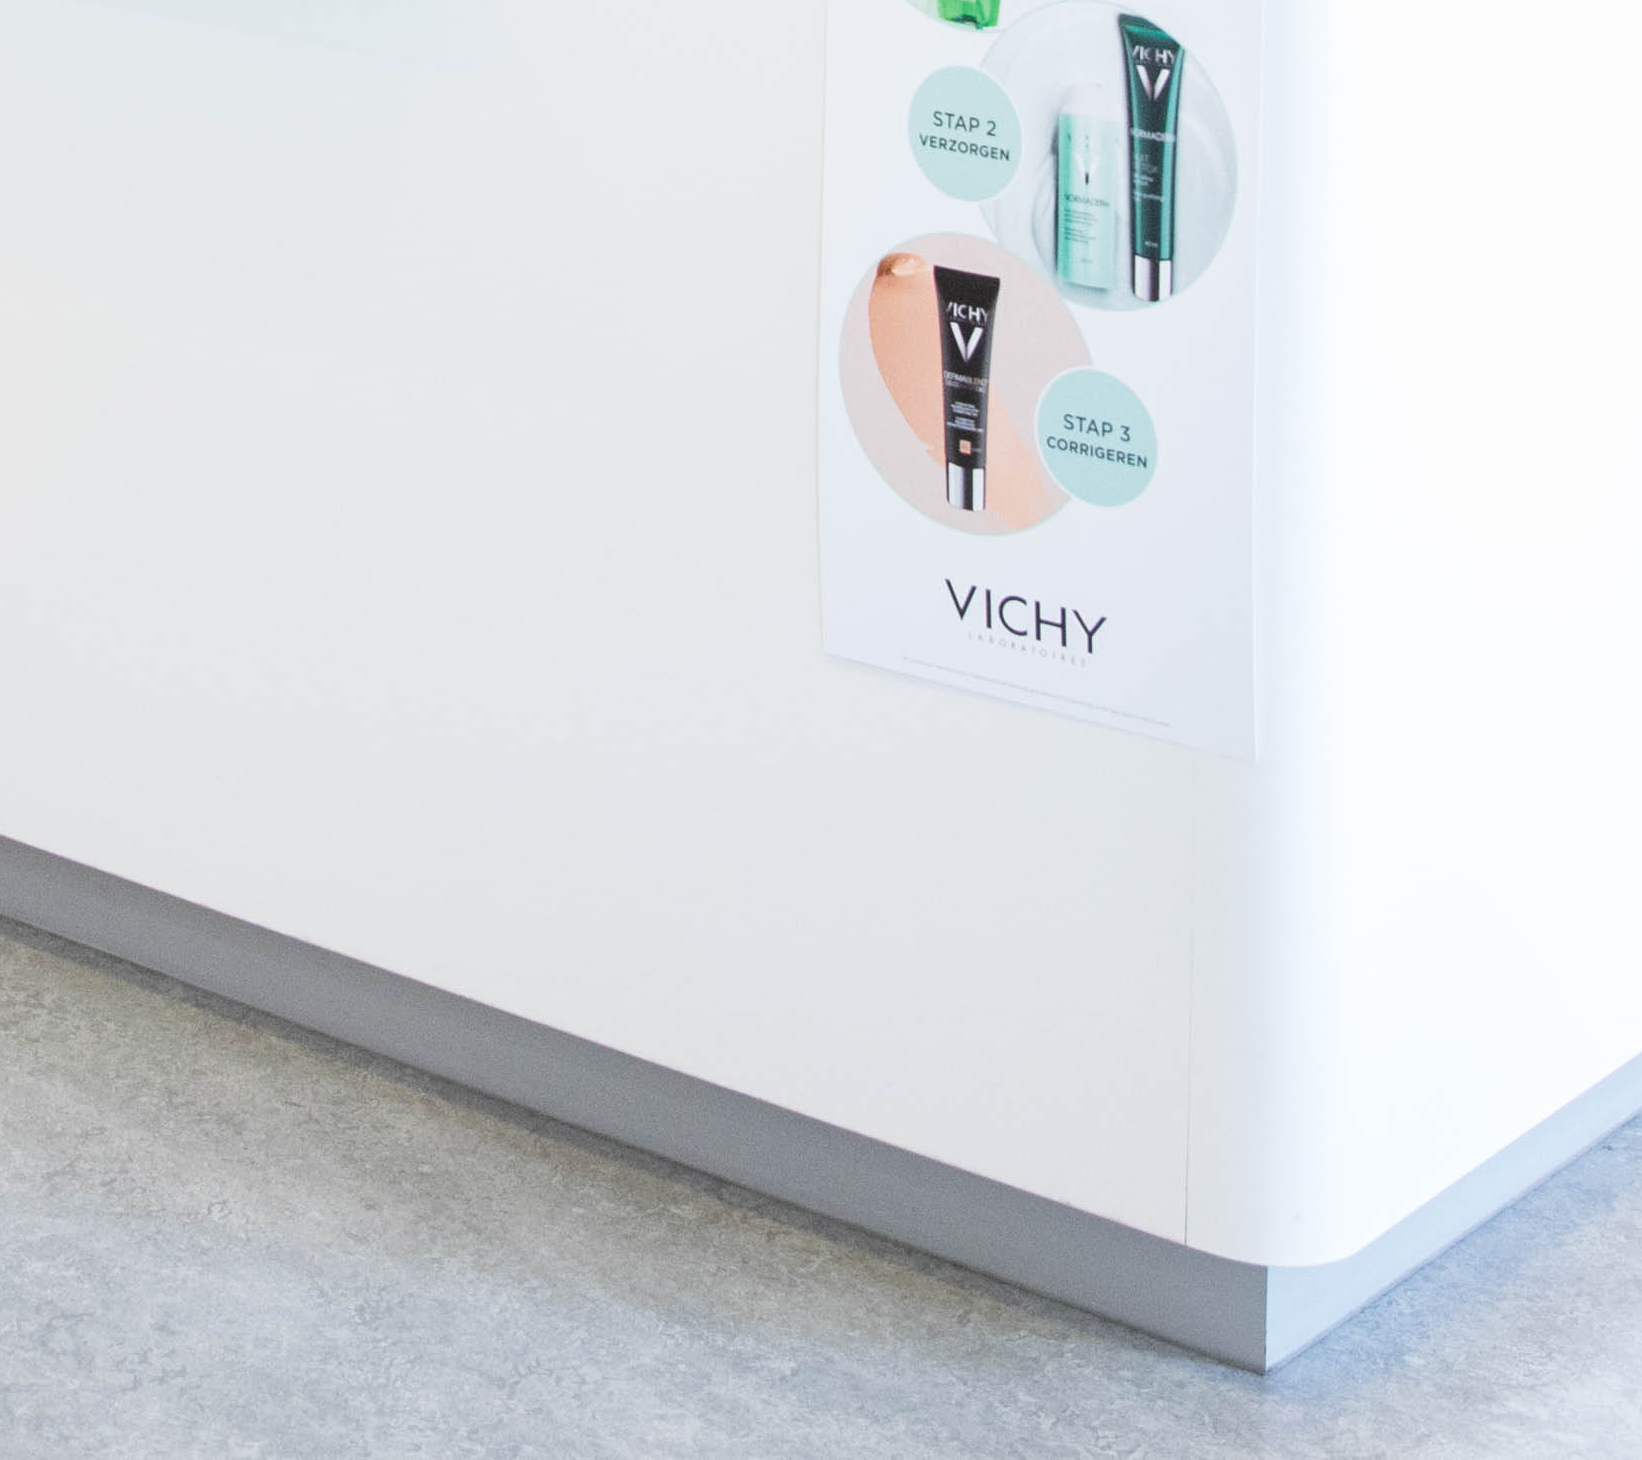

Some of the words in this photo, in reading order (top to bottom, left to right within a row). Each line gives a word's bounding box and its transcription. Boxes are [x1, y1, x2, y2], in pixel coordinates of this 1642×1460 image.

[933, 110, 981, 134] STAP
[986, 120, 997, 137] 2
[919, 134, 1011, 162] VERZORGEN
[1063, 413, 1114, 439] STAP
[1120, 425, 1131, 443] 3
[1045, 435, 1149, 469] CORRIGEREN
[944, 578, 1107, 655] VICHY
